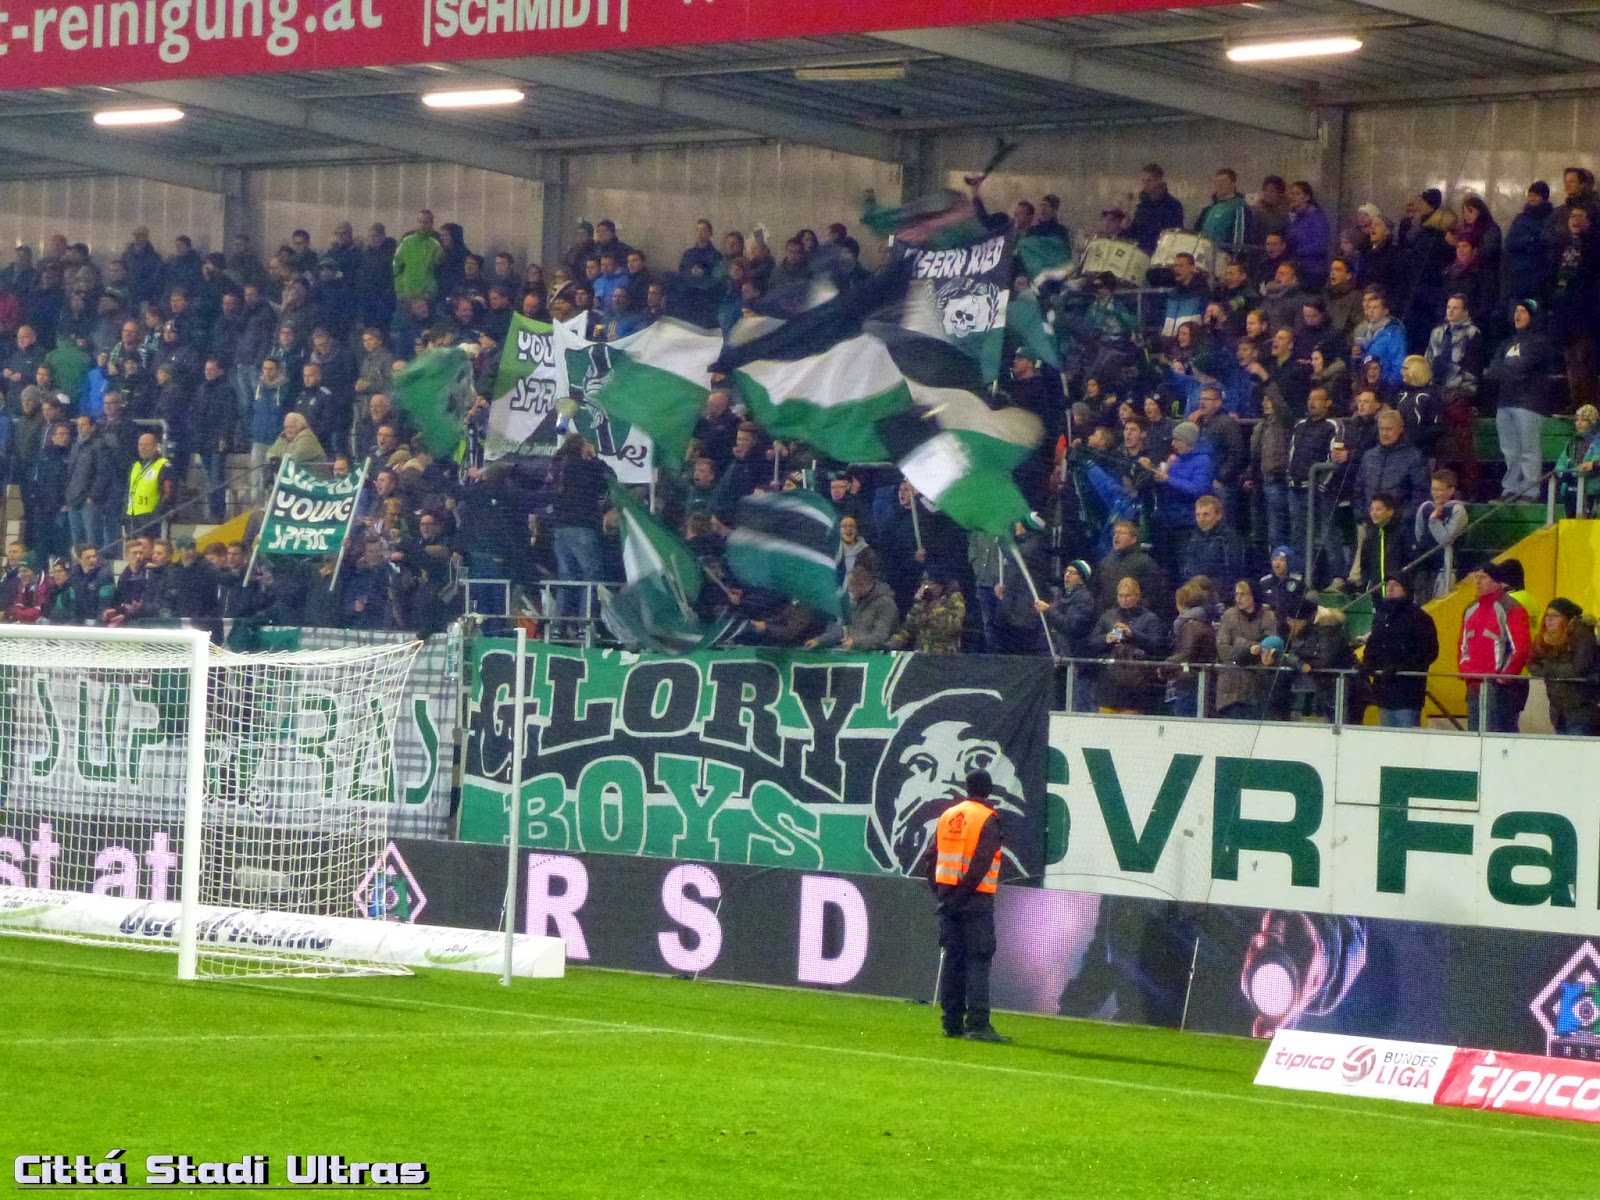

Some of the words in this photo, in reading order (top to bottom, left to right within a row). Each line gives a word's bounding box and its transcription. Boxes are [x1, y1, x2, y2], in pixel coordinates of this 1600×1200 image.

[476, 650, 868, 802] GLORY
[503, 753, 822, 870] BOYS
[1045, 745, 1324, 888] VR
[1377, 766, 1600, 910] Fa
[1274, 1048, 1335, 1071] tipico
[1375, 1065, 1430, 1089] LIGA
[1384, 1051, 1438, 1068] BUNDES
